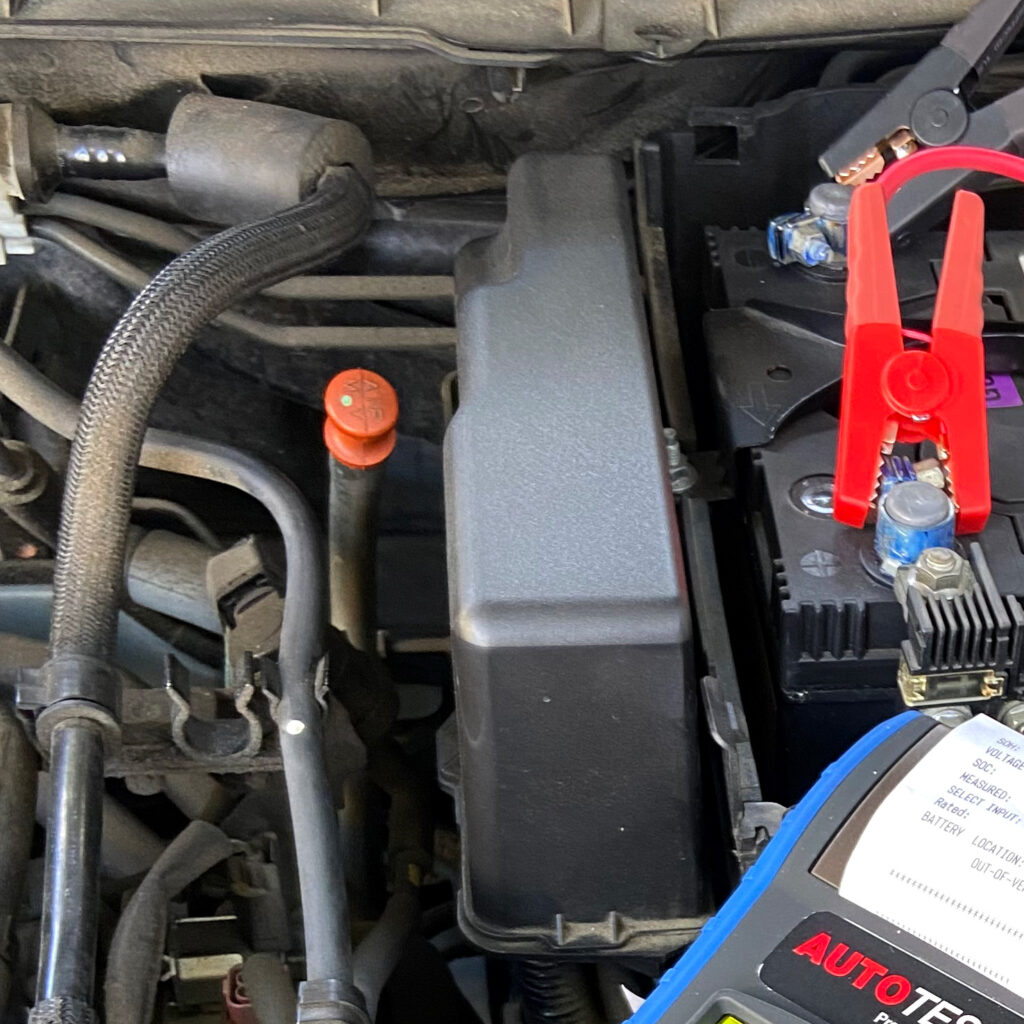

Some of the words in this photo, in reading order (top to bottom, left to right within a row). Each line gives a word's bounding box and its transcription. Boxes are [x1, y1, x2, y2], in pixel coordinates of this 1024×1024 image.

[972, 757, 997, 776] SOC:
[959, 771, 1012, 803] MEASURED:
[933, 797, 971, 820] Rated:
[947, 785, 986, 807] SELECT
[986, 803, 1021, 825] INPUT:
[920, 810, 966, 838] BATTERY
[971, 835, 1024, 868] LOCATION:
